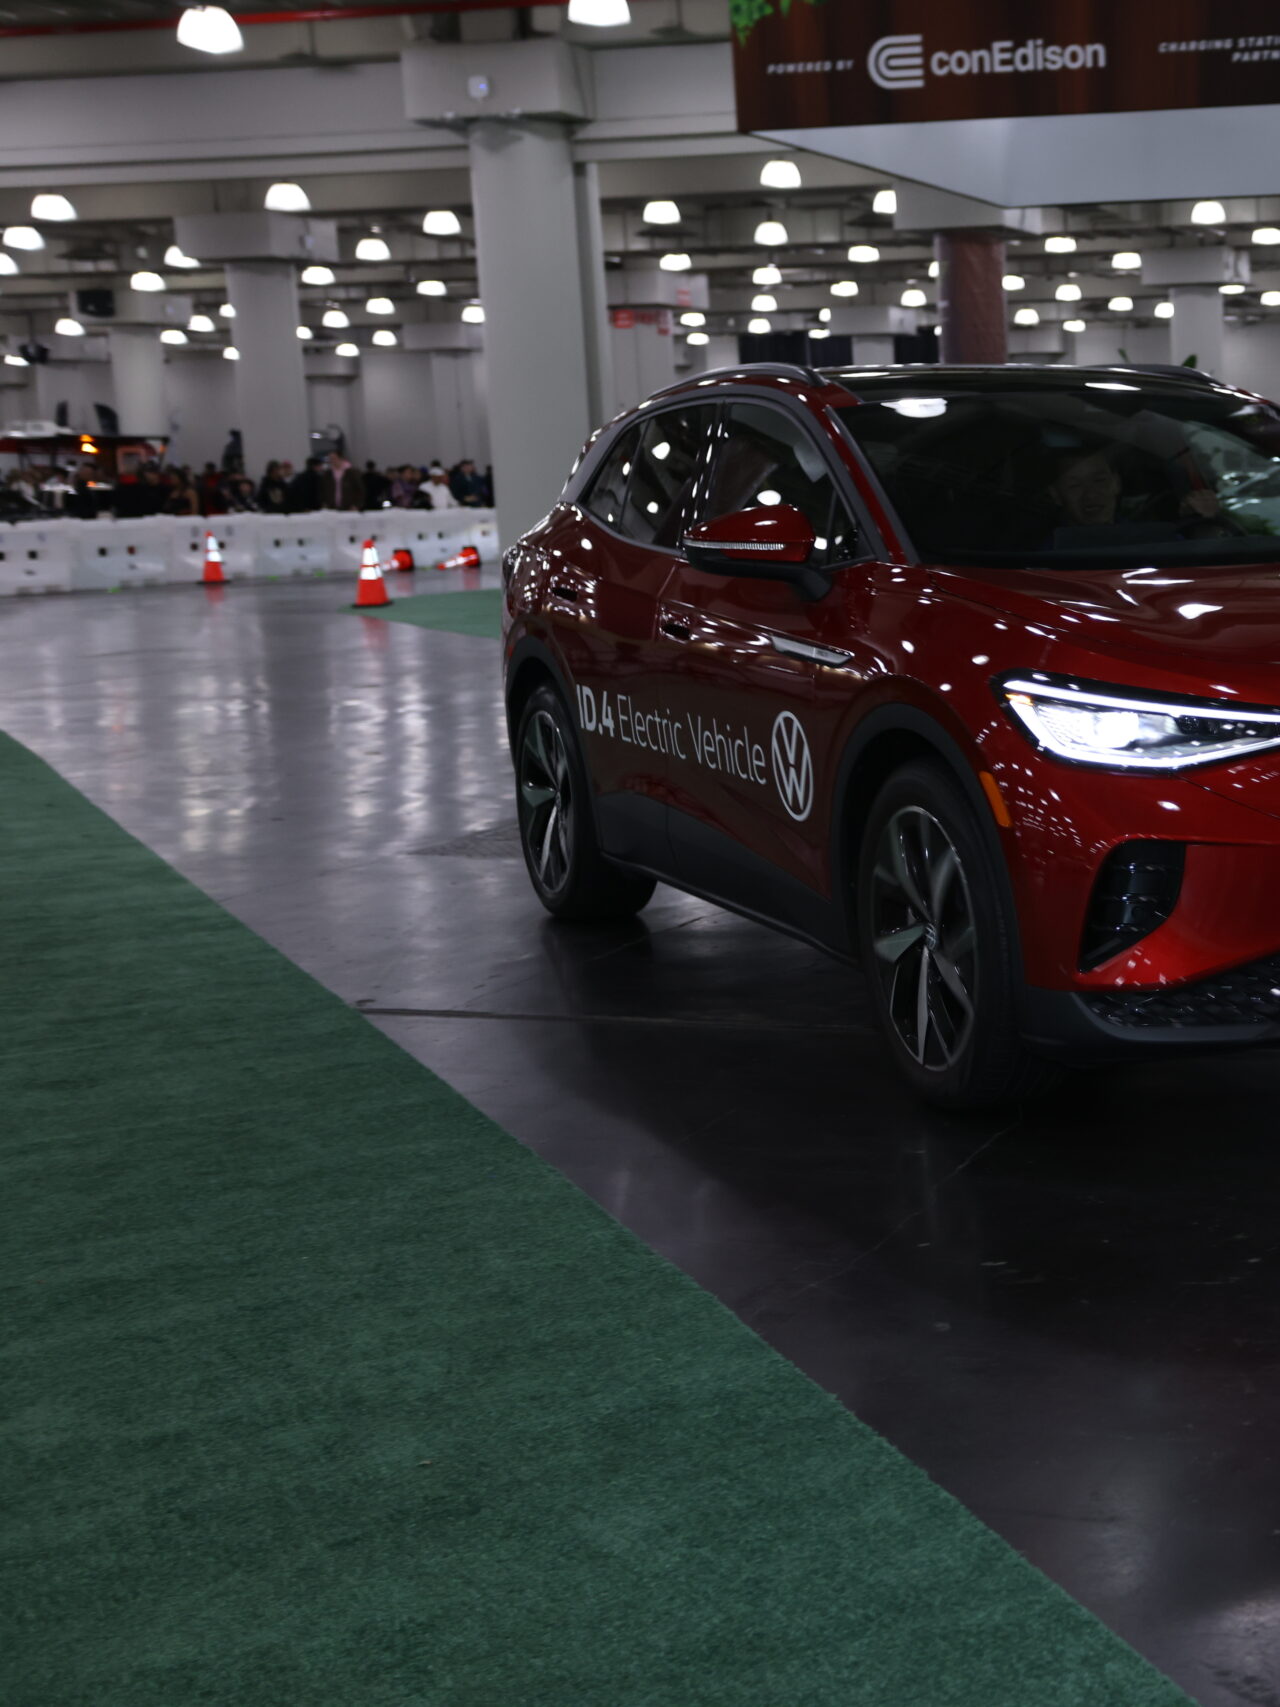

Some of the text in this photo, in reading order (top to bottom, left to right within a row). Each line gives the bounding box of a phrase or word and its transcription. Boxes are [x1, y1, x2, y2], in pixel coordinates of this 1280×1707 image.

[930, 39, 1106, 76] conEdison
[1158, 38, 1233, 53] CHARGING
[766, 59, 854, 75] POWERED BY
[576, 684, 767, 785] ID.4 Electric Vehicle
[771, 710, 814, 822] VW
